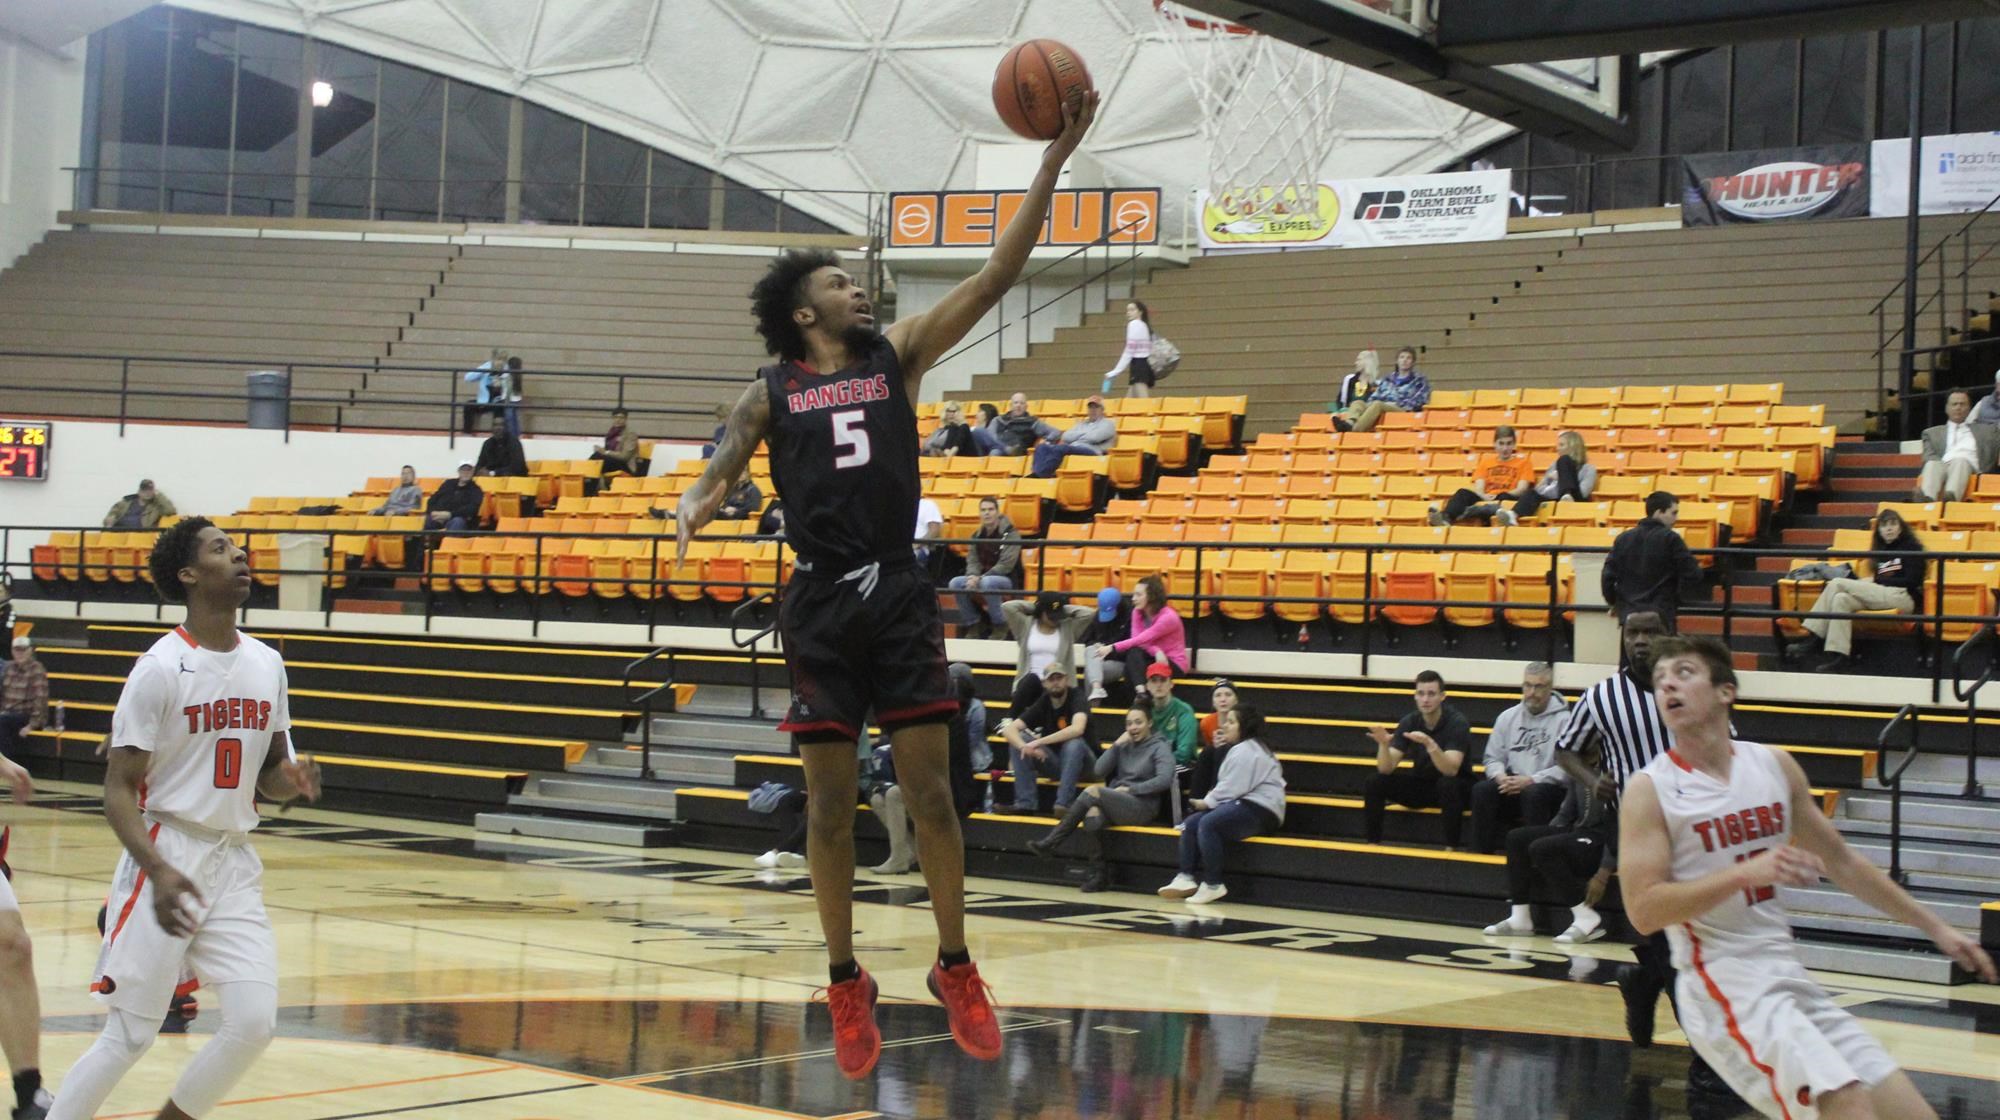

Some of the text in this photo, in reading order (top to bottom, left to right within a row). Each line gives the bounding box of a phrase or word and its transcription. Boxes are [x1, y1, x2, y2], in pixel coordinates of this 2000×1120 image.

[1411, 185, 1482, 198] OKLAHOMA
[1707, 162, 1863, 203] HUNTER
[1405, 206, 1477, 218] INSURANCE
[1408, 198, 1445, 209] FARM
[1743, 200, 1774, 208] HEAT
[1790, 196, 1814, 204] AIR
[1269, 220, 1320, 232] EXPRES
[787, 373, 890, 414] RANGERS
[831, 409, 871, 469] 5
[0, 447, 37, 477] 27
[183, 697, 272, 735] TIGERS
[213, 737, 243, 790] 0
[1692, 801, 1785, 853] TIGERS
